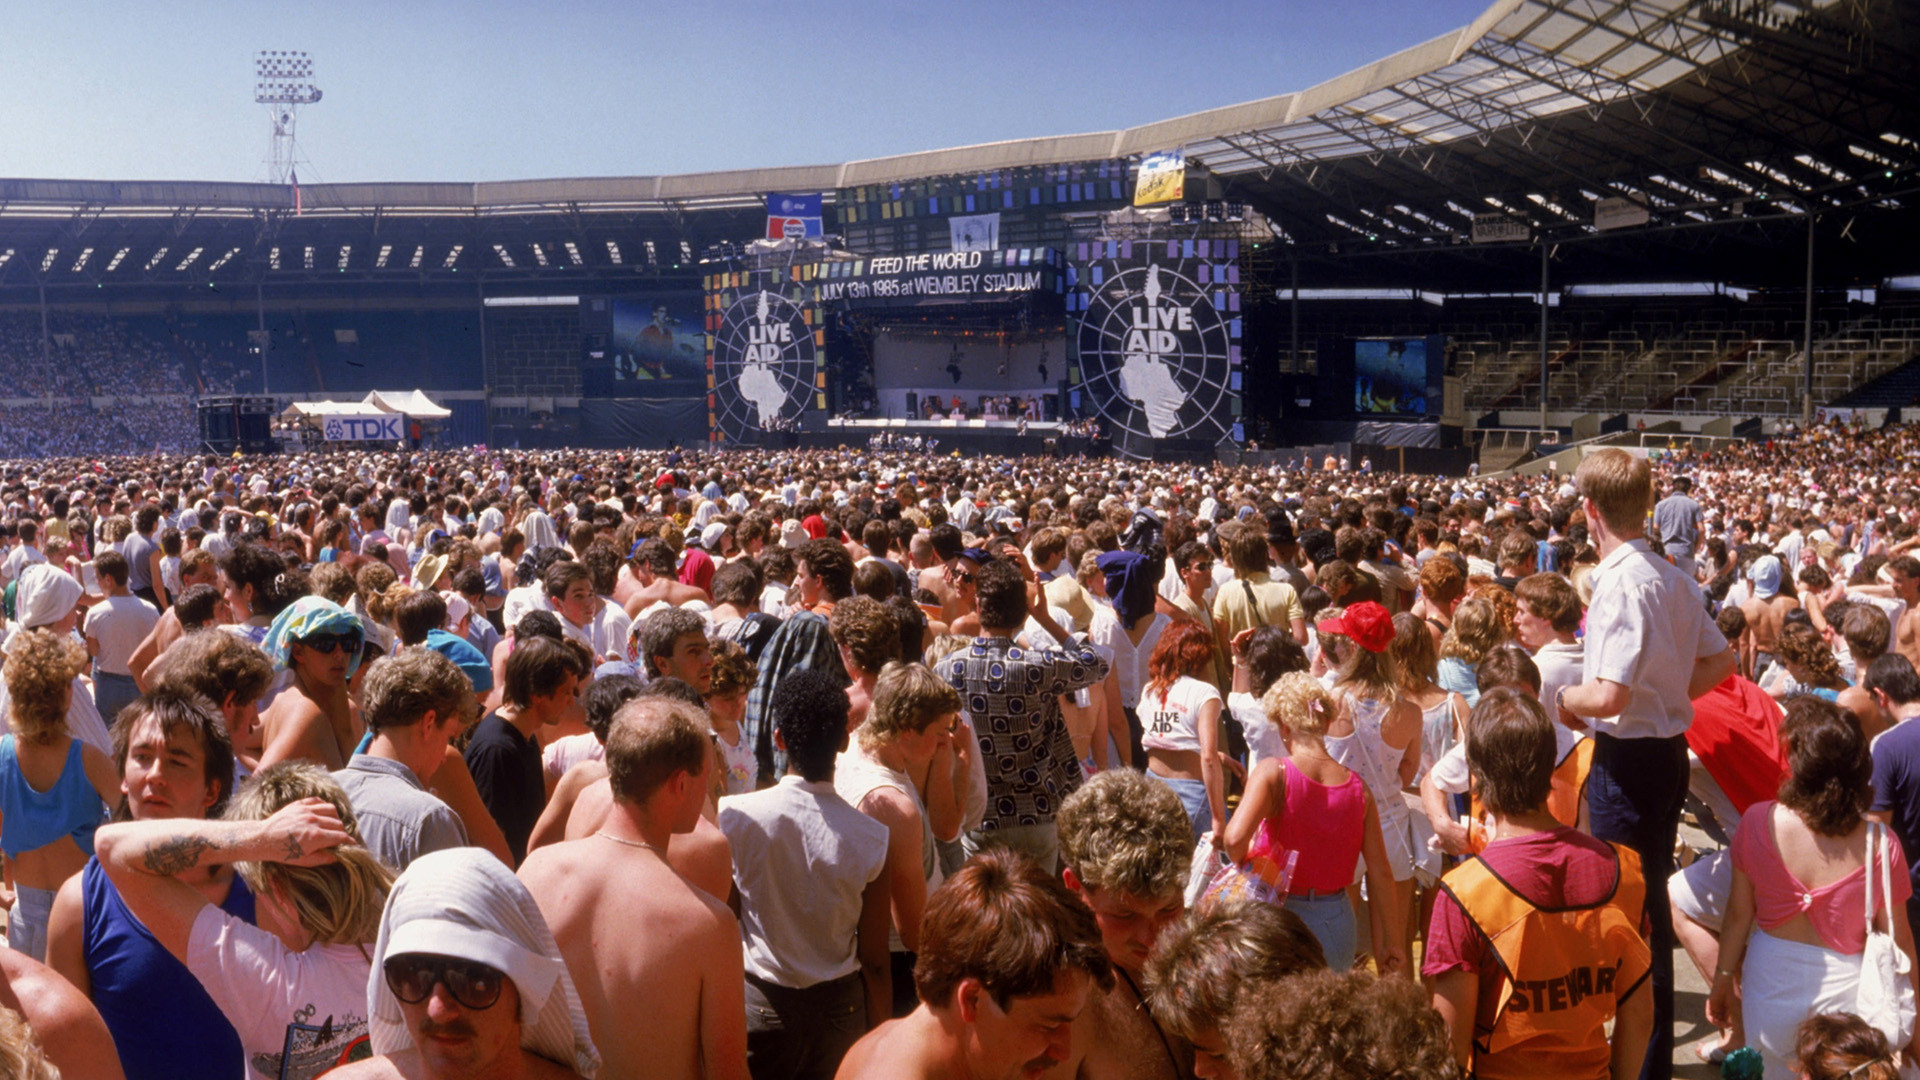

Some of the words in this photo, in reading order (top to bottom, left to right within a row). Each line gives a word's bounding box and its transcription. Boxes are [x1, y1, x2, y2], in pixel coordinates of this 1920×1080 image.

[870, 257, 902, 275] FEED
[905, 254, 930, 272] THE
[933, 251, 981, 270] WORLD
[821, 282, 844, 301] JULY
[847, 281, 871, 299] 13th
[872, 279, 900, 297] 1985
[901, 279, 914, 296] at
[915, 274, 980, 295] WEMBLEY
[984, 271, 1041, 293] STADIUM
[1132, 306, 1193, 331] LIVE
[749, 322, 791, 344] LIVE
[1127, 329, 1177, 353] AID
[745, 344, 780, 362] AID
[343, 418, 400, 440] TDK
[1150, 722, 1172, 734] AID
[1154, 711, 1180, 723] LIVE
[1508, 957, 1623, 1013] STEWAR
